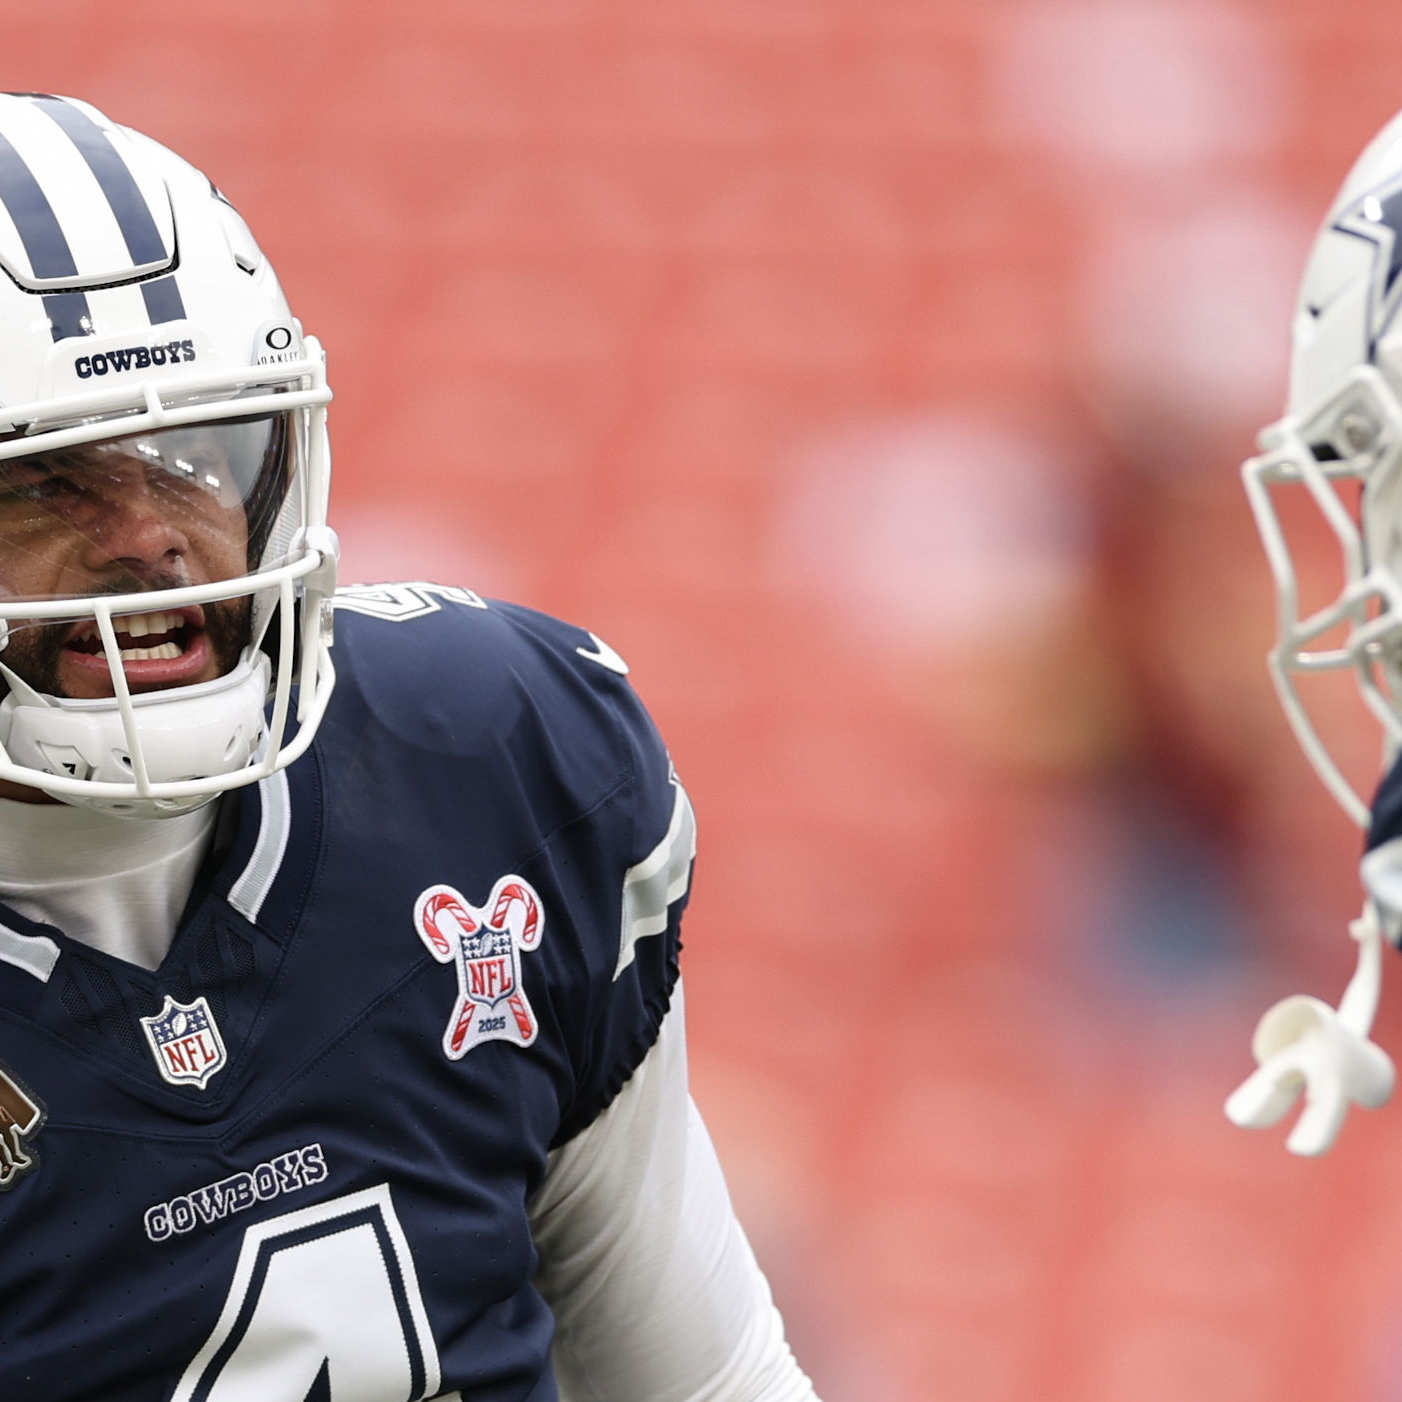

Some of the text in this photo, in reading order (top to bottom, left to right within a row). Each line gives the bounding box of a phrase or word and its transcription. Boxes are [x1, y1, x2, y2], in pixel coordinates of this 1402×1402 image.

[75, 339, 196, 379] COWBOYS
[468, 958, 512, 998] NFL
[478, 1016, 506, 1033] 2025
[164, 1034, 216, 1073] NFL
[144, 1143, 329, 1241] COWBOYS
